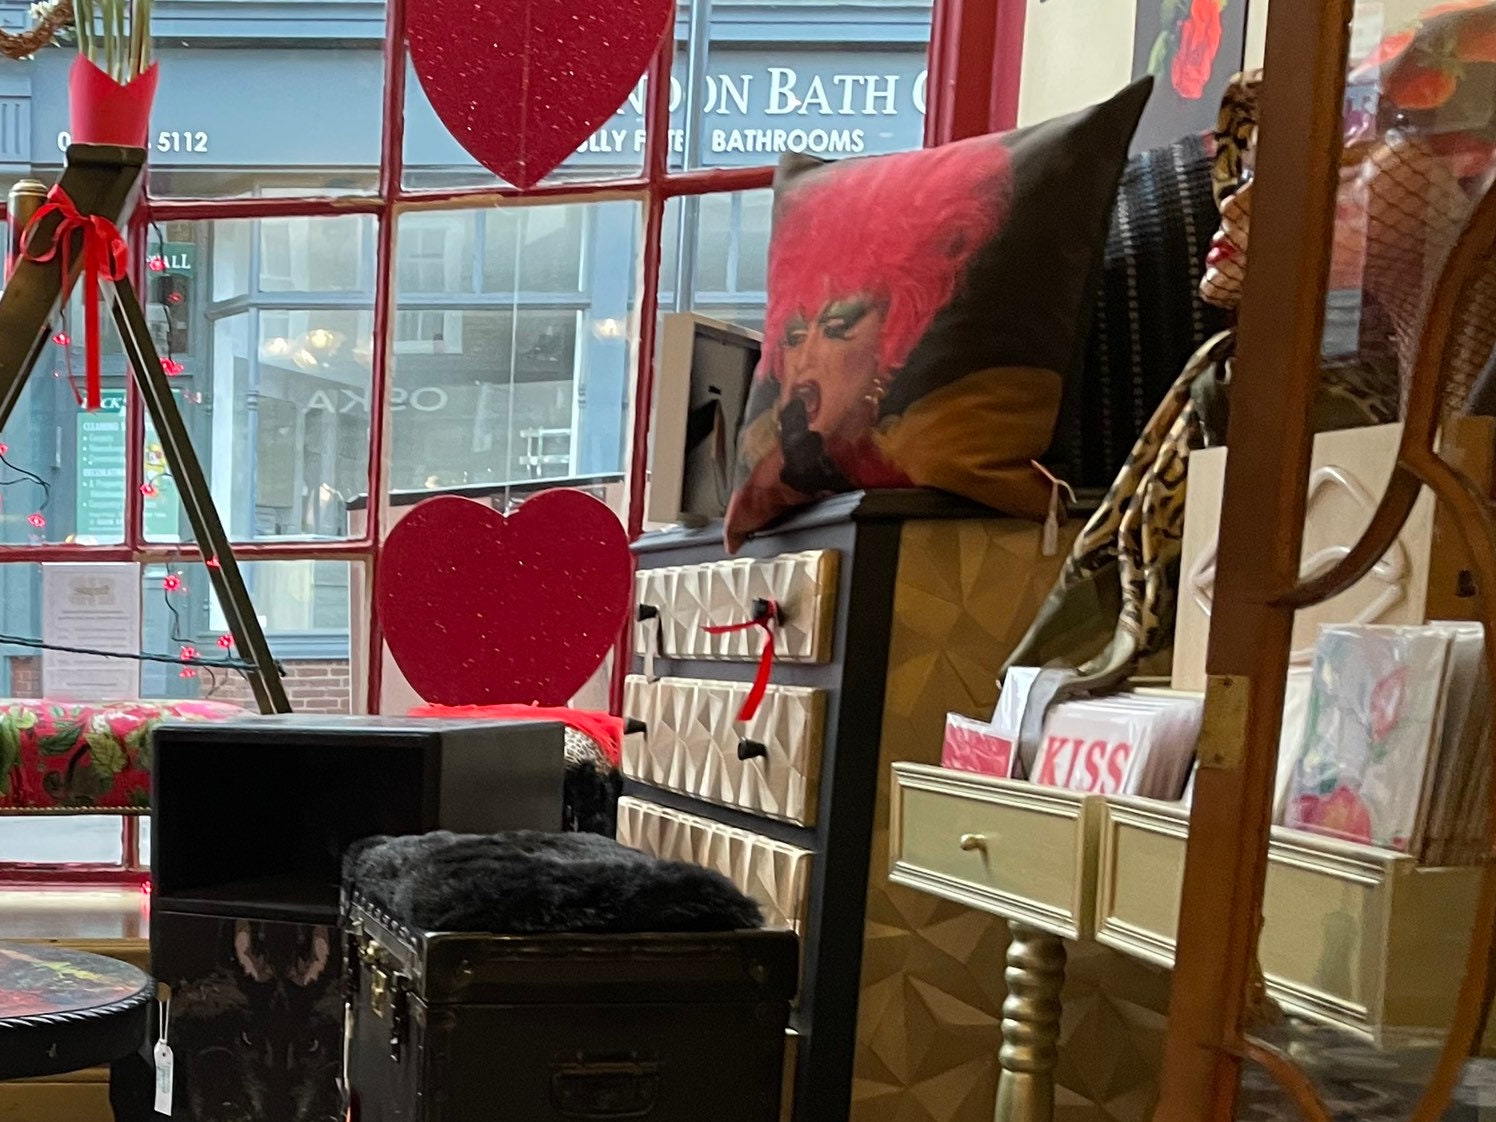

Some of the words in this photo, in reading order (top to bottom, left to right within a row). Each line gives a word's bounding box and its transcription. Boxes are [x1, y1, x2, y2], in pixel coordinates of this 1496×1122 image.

[764, 67, 899, 115] BATH
[157, 131, 208, 153] 5112
[711, 128, 865, 153] BATHROOMS
[1037, 735, 1132, 795] KISS
